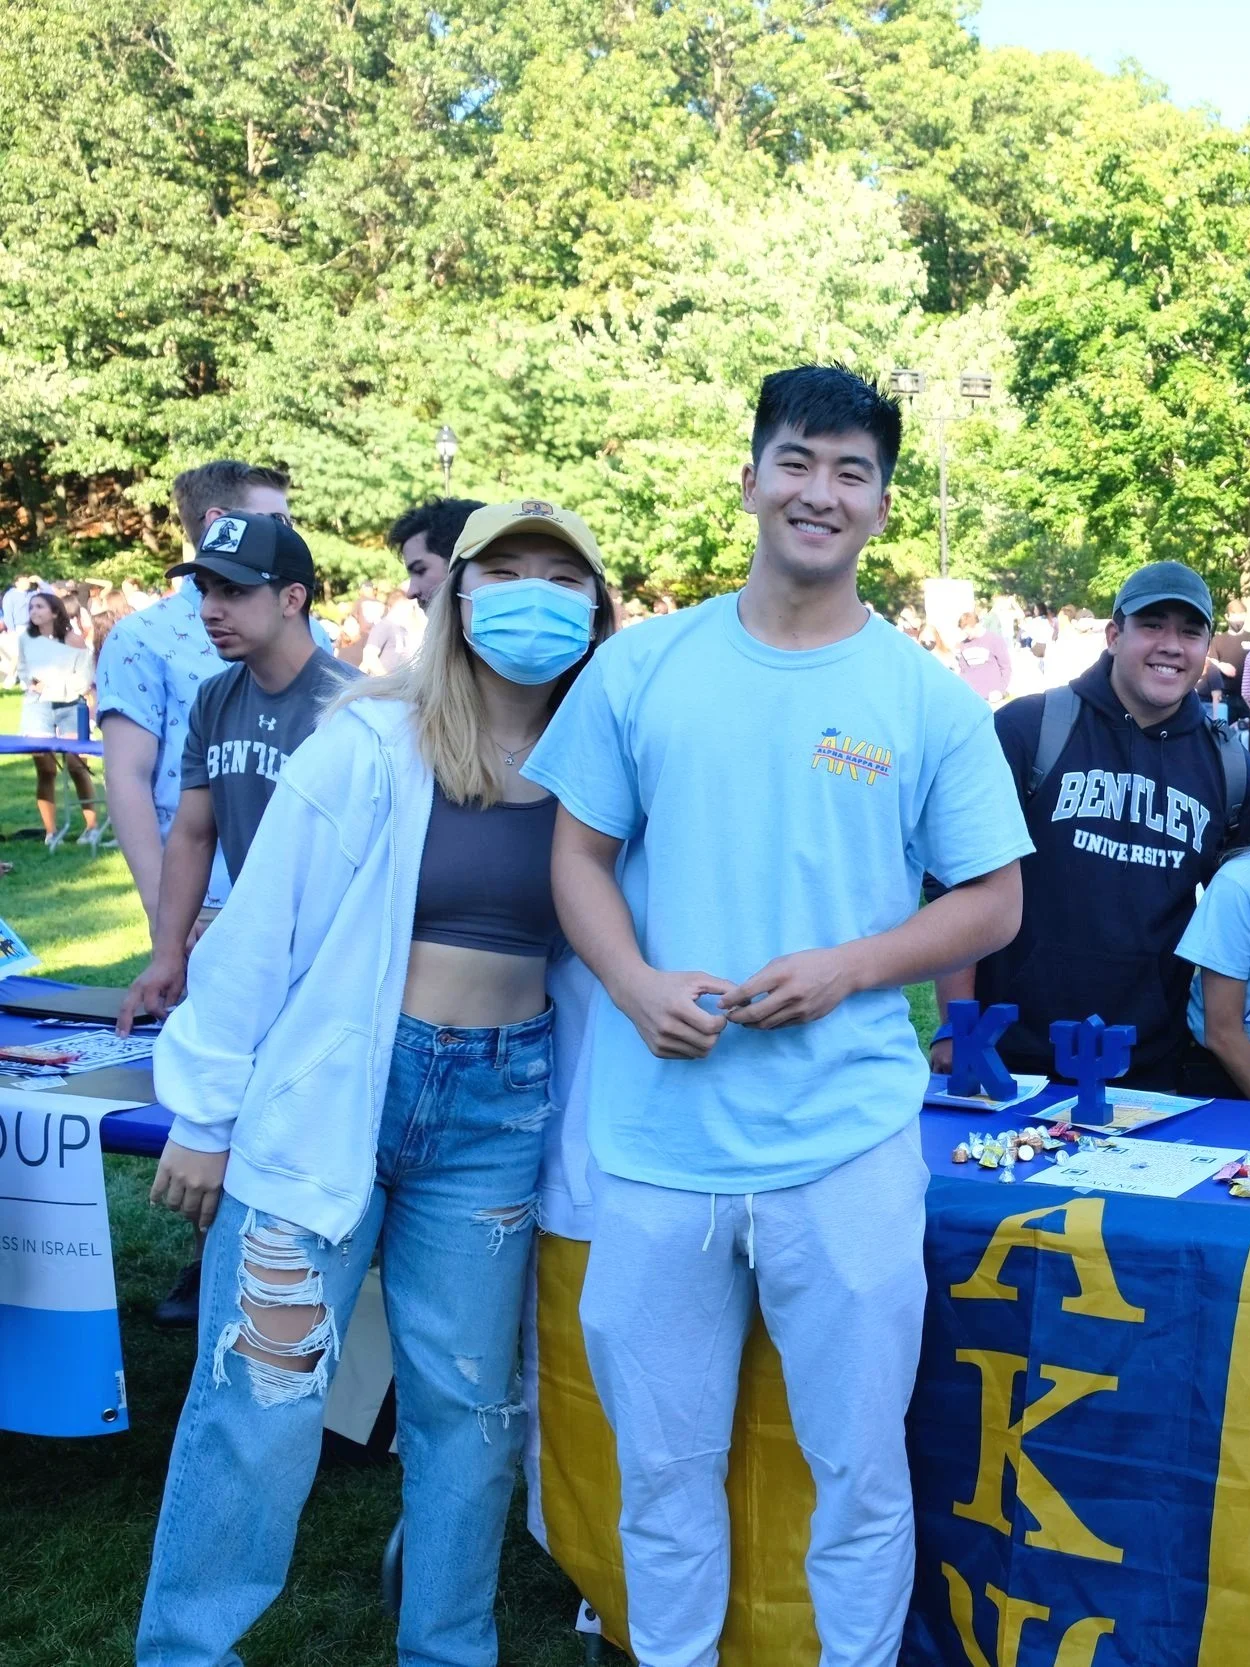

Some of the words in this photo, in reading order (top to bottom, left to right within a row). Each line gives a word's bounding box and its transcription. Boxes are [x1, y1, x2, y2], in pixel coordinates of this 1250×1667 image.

[207, 740, 290, 780] BENTL
[817, 748, 843, 759] ALPHA
[846, 755, 873, 768] KAPPA
[875, 764, 888, 773] PSI
[1051, 769, 1211, 854] BENTLEY
[1073, 829, 1186, 869] UNIVERSITY
[0, 1236, 18, 1251] SS
[23, 1239, 36, 1253] IN
[42, 1240, 103, 1257] ISRAEL
